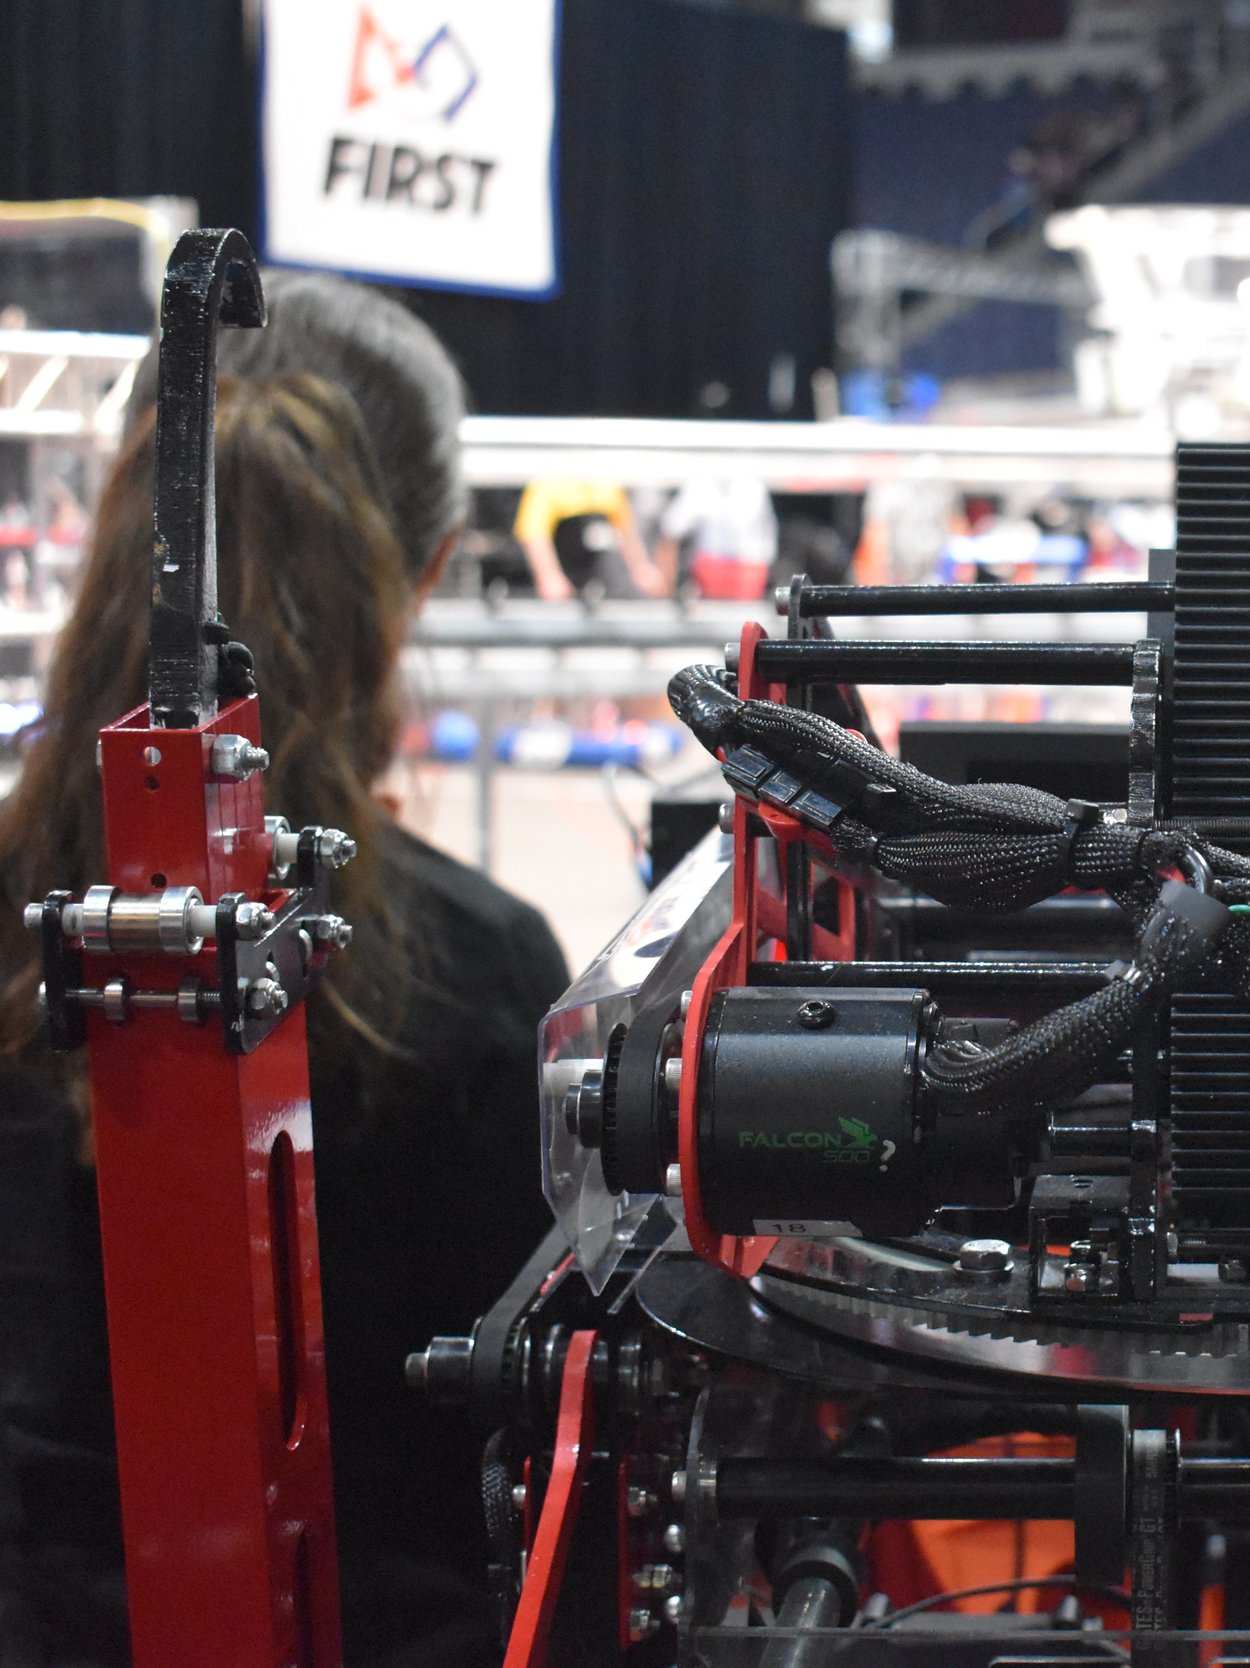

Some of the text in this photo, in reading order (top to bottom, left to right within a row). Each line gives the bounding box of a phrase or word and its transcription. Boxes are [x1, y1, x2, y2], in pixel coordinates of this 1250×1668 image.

[323, 135, 497, 214] FIRST
[739, 1131, 842, 1148] FALCON
[823, 1150, 871, 1163] 500
[773, 1223, 806, 1234] 18
